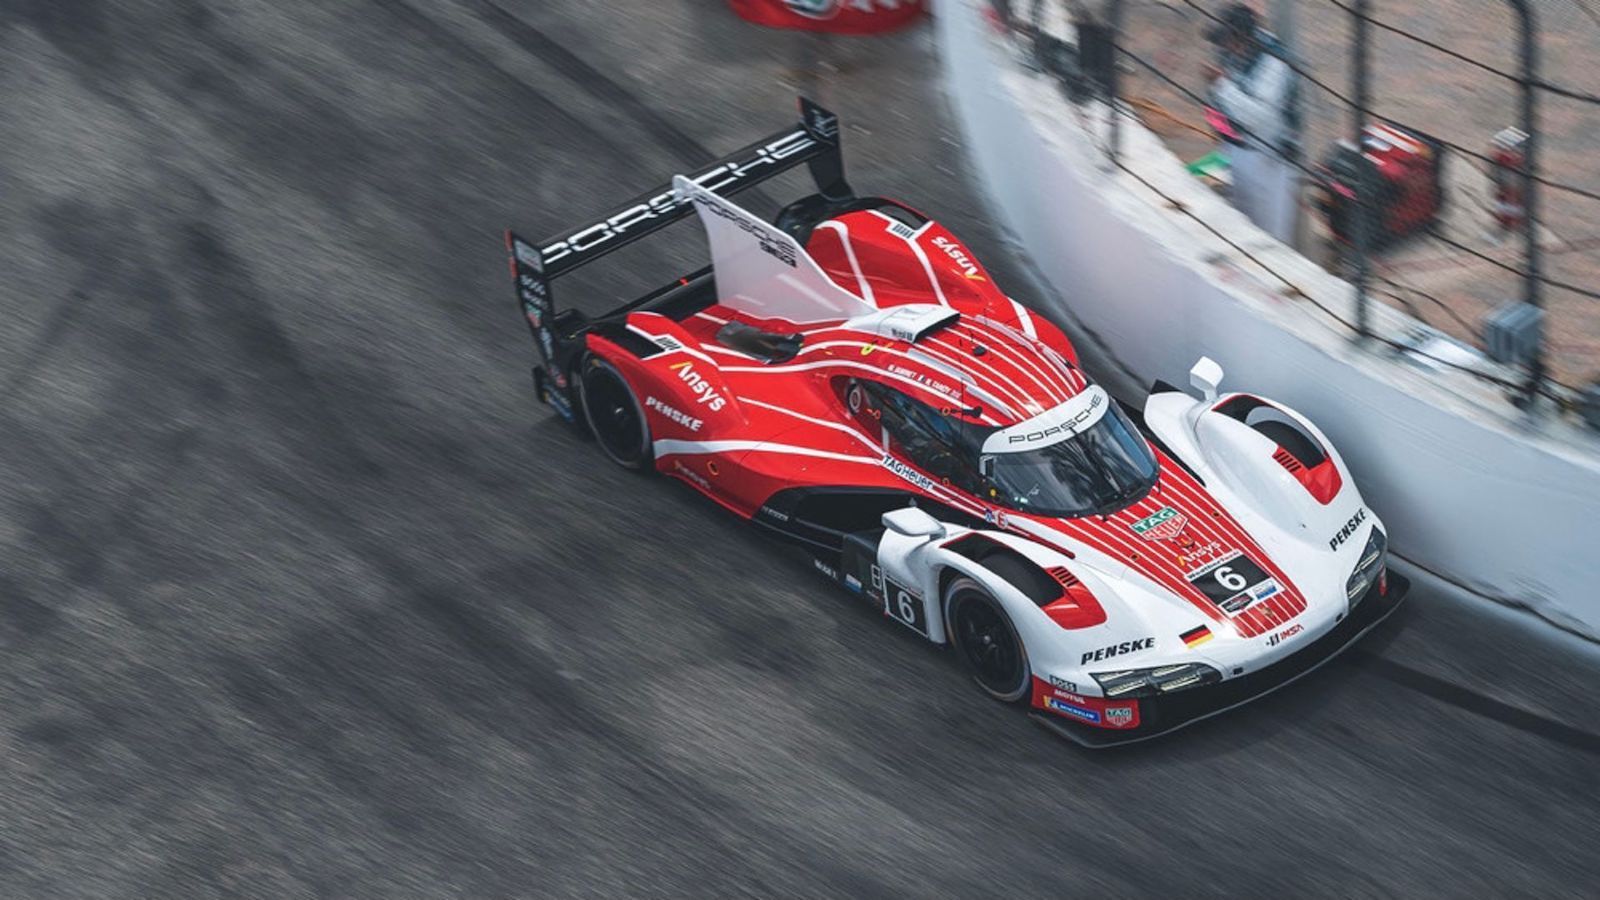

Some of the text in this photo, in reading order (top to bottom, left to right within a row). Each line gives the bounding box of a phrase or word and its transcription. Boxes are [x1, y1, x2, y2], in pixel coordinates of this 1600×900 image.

[693, 193, 797, 258] PORSCHE
[931, 236, 985, 281] Ansys
[669, 361, 726, 411] Ansys
[645, 396, 703, 432] PENSKE
[1008, 393, 1102, 444] PORSCHE
[1133, 508, 1175, 531] TAG
[1142, 514, 1184, 539] HEUER
[1329, 508, 1366, 552] PENSKE
[1178, 541, 1220, 566] Ansys
[1214, 566, 1247, 590] 6
[897, 590, 915, 624] 6
[1081, 637, 1155, 665] PENSKE
